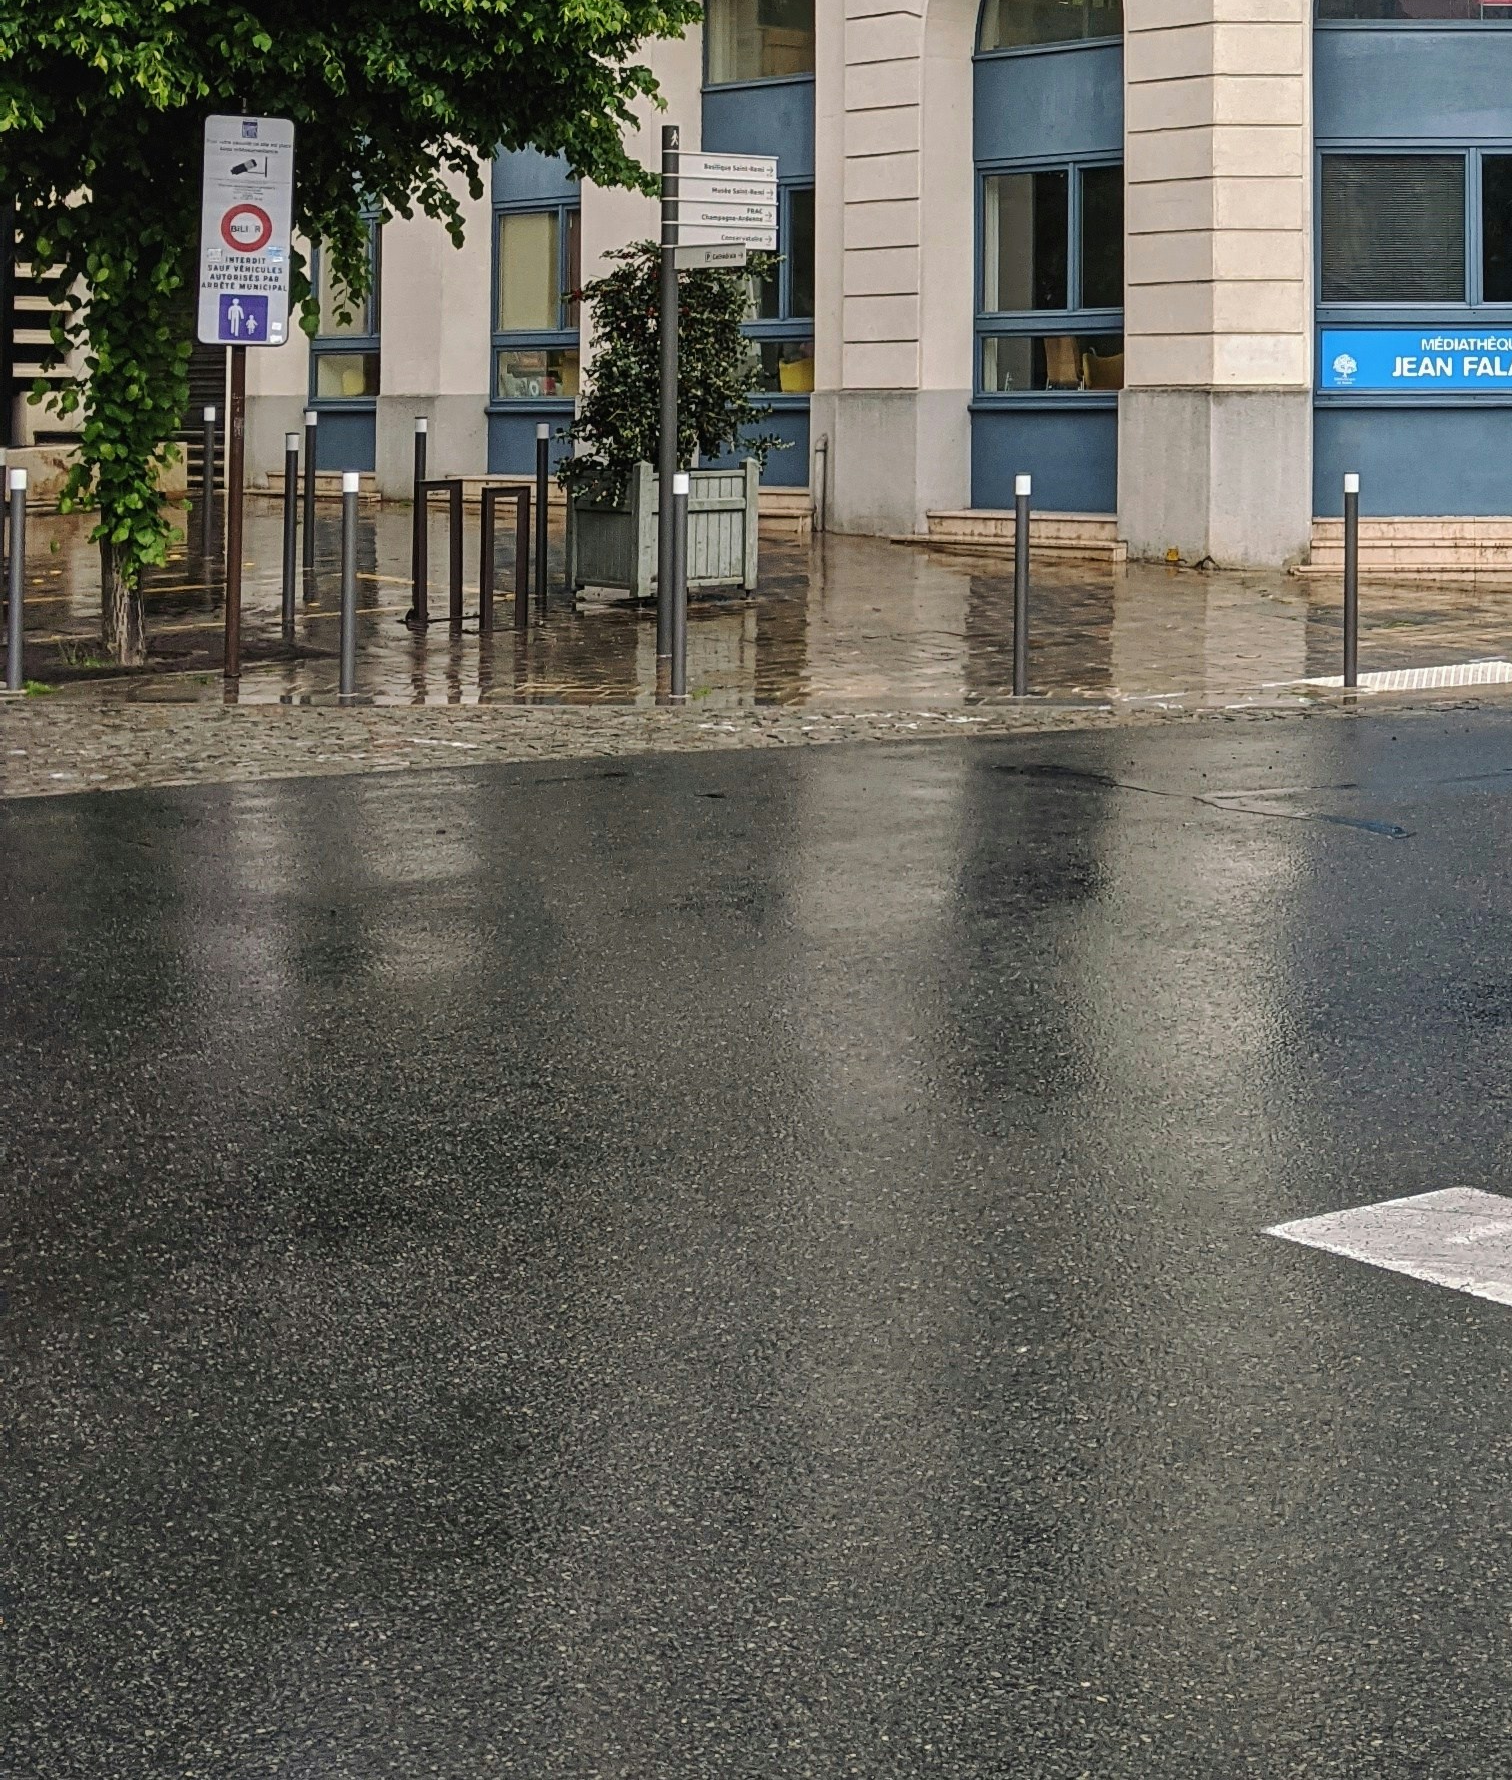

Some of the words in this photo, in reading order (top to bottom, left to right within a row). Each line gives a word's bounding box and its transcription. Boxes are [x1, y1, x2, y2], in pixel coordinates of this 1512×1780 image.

[703, 163, 731, 172] Basilique
[732, 165, 765, 173] Saint-Remi
[711, 186, 731, 194] Musée
[225, 256, 266, 264] INTERDIT
[207, 264, 231, 272] SAUF
[233, 265, 283, 274] VÉHICULES
[209, 273, 260, 282] AUTORISÉS
[201, 281, 235, 290] ARRÊTÉ
[239, 283, 287, 292] MUNICIPAL
[1392, 356, 1453, 377] JEAN
